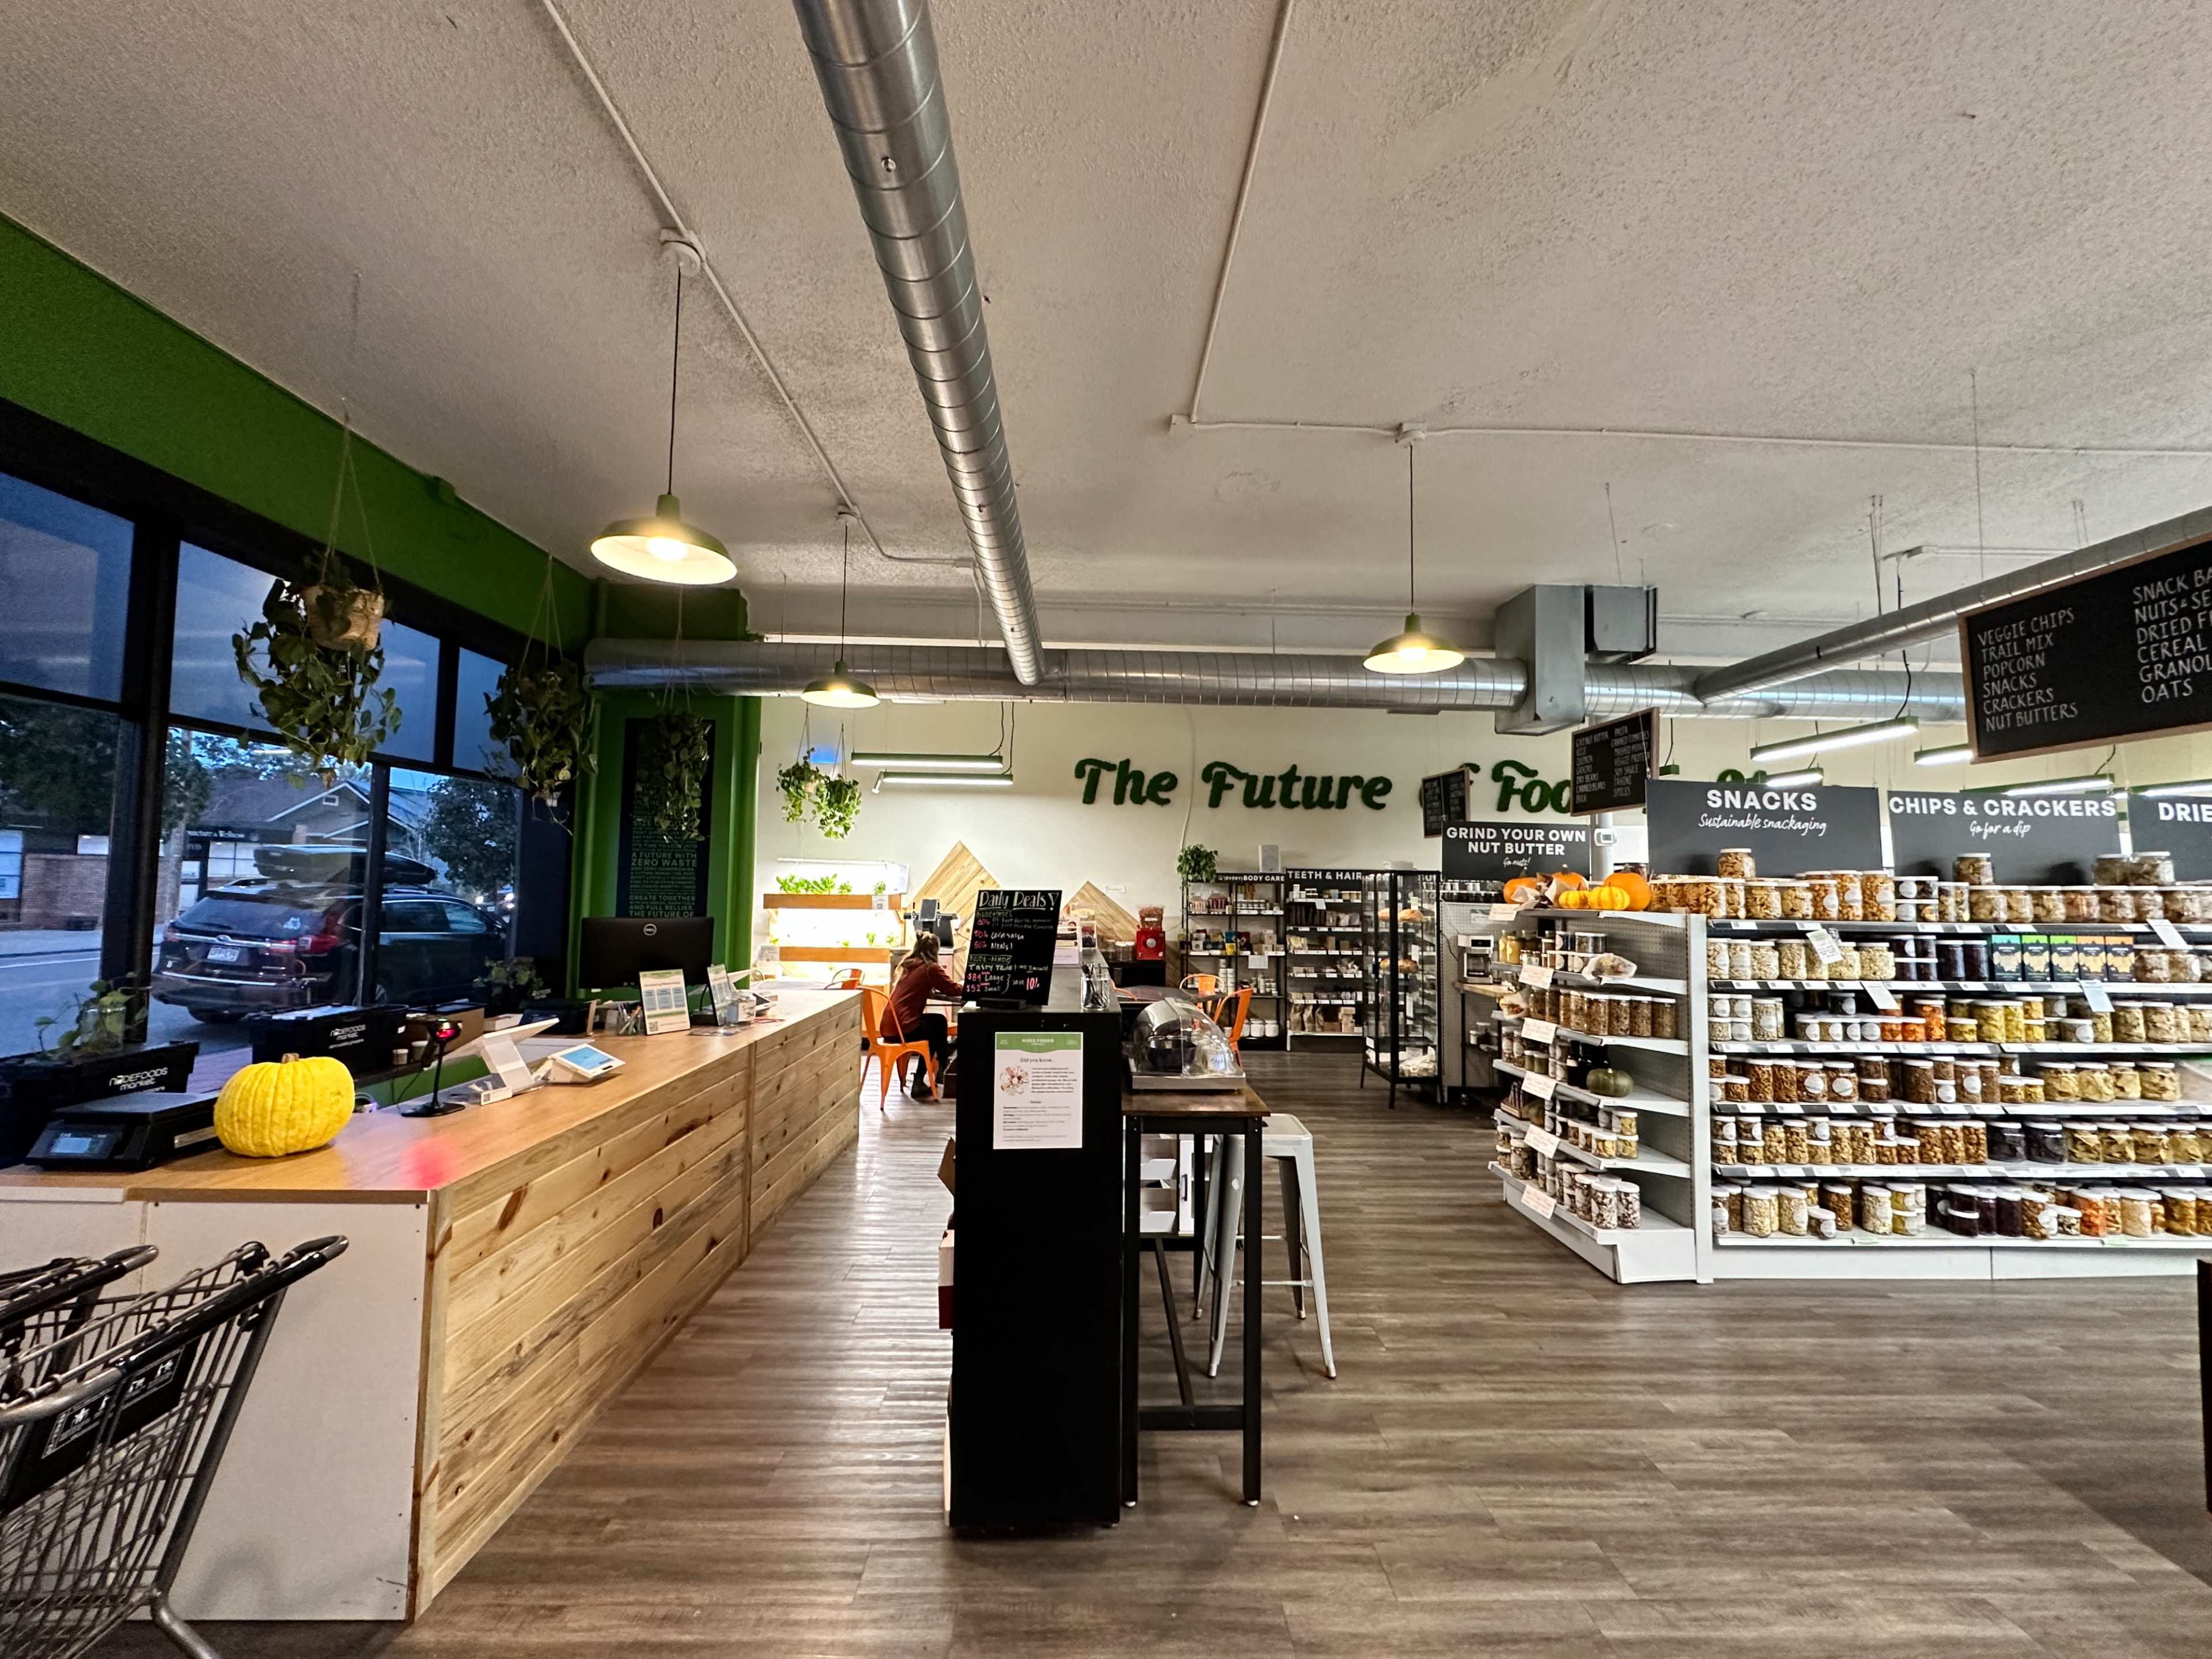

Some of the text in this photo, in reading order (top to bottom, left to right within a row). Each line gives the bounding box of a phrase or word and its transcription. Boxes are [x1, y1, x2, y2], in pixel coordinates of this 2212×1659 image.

[2133, 567, 2212, 604] SNACK BA
[2135, 598, 2178, 624] NUTS
[1978, 607, 2074, 646] VEGGIE CHIPS
[2137, 617, 2192, 645] DRIED
[1981, 632, 2055, 663] TRAIL MIX
[2138, 634, 2207, 663] CEREAL
[1983, 652, 2046, 680] POPCORN
[2139, 654, 2212, 683] GRANOL
[1983, 672, 2037, 698] SNACKS
[2142, 678, 2193, 703] OATS
[1983, 687, 2054, 715] CRACKERS
[1986, 702, 2078, 732] NUT BUTTERS
[1075, 758, 1178, 806] The
[1202, 761, 1392, 809] Future
[1492, 760, 1571, 813] Foo
[1707, 789, 1817, 811] SNACKS
[1889, 797, 2116, 817] CHIPS & CRACKERS
[2158, 802, 2212, 822] DRIE
[1446, 827, 1586, 842] GRIND YOUR OWN
[1698, 813, 1827, 836] Sustainable snackaging
[1970, 821, 2031, 839] Go for a dip
[1468, 842, 1565, 855] NUT BUTTER
[631, 858, 698, 867] ZERO WASTE
[1287, 871, 1322, 879] TEETH
[1336, 872, 1362, 880] HAIR
[979, 891, 1009, 908] Daily
[1026, 978, 1040, 991] 10%
